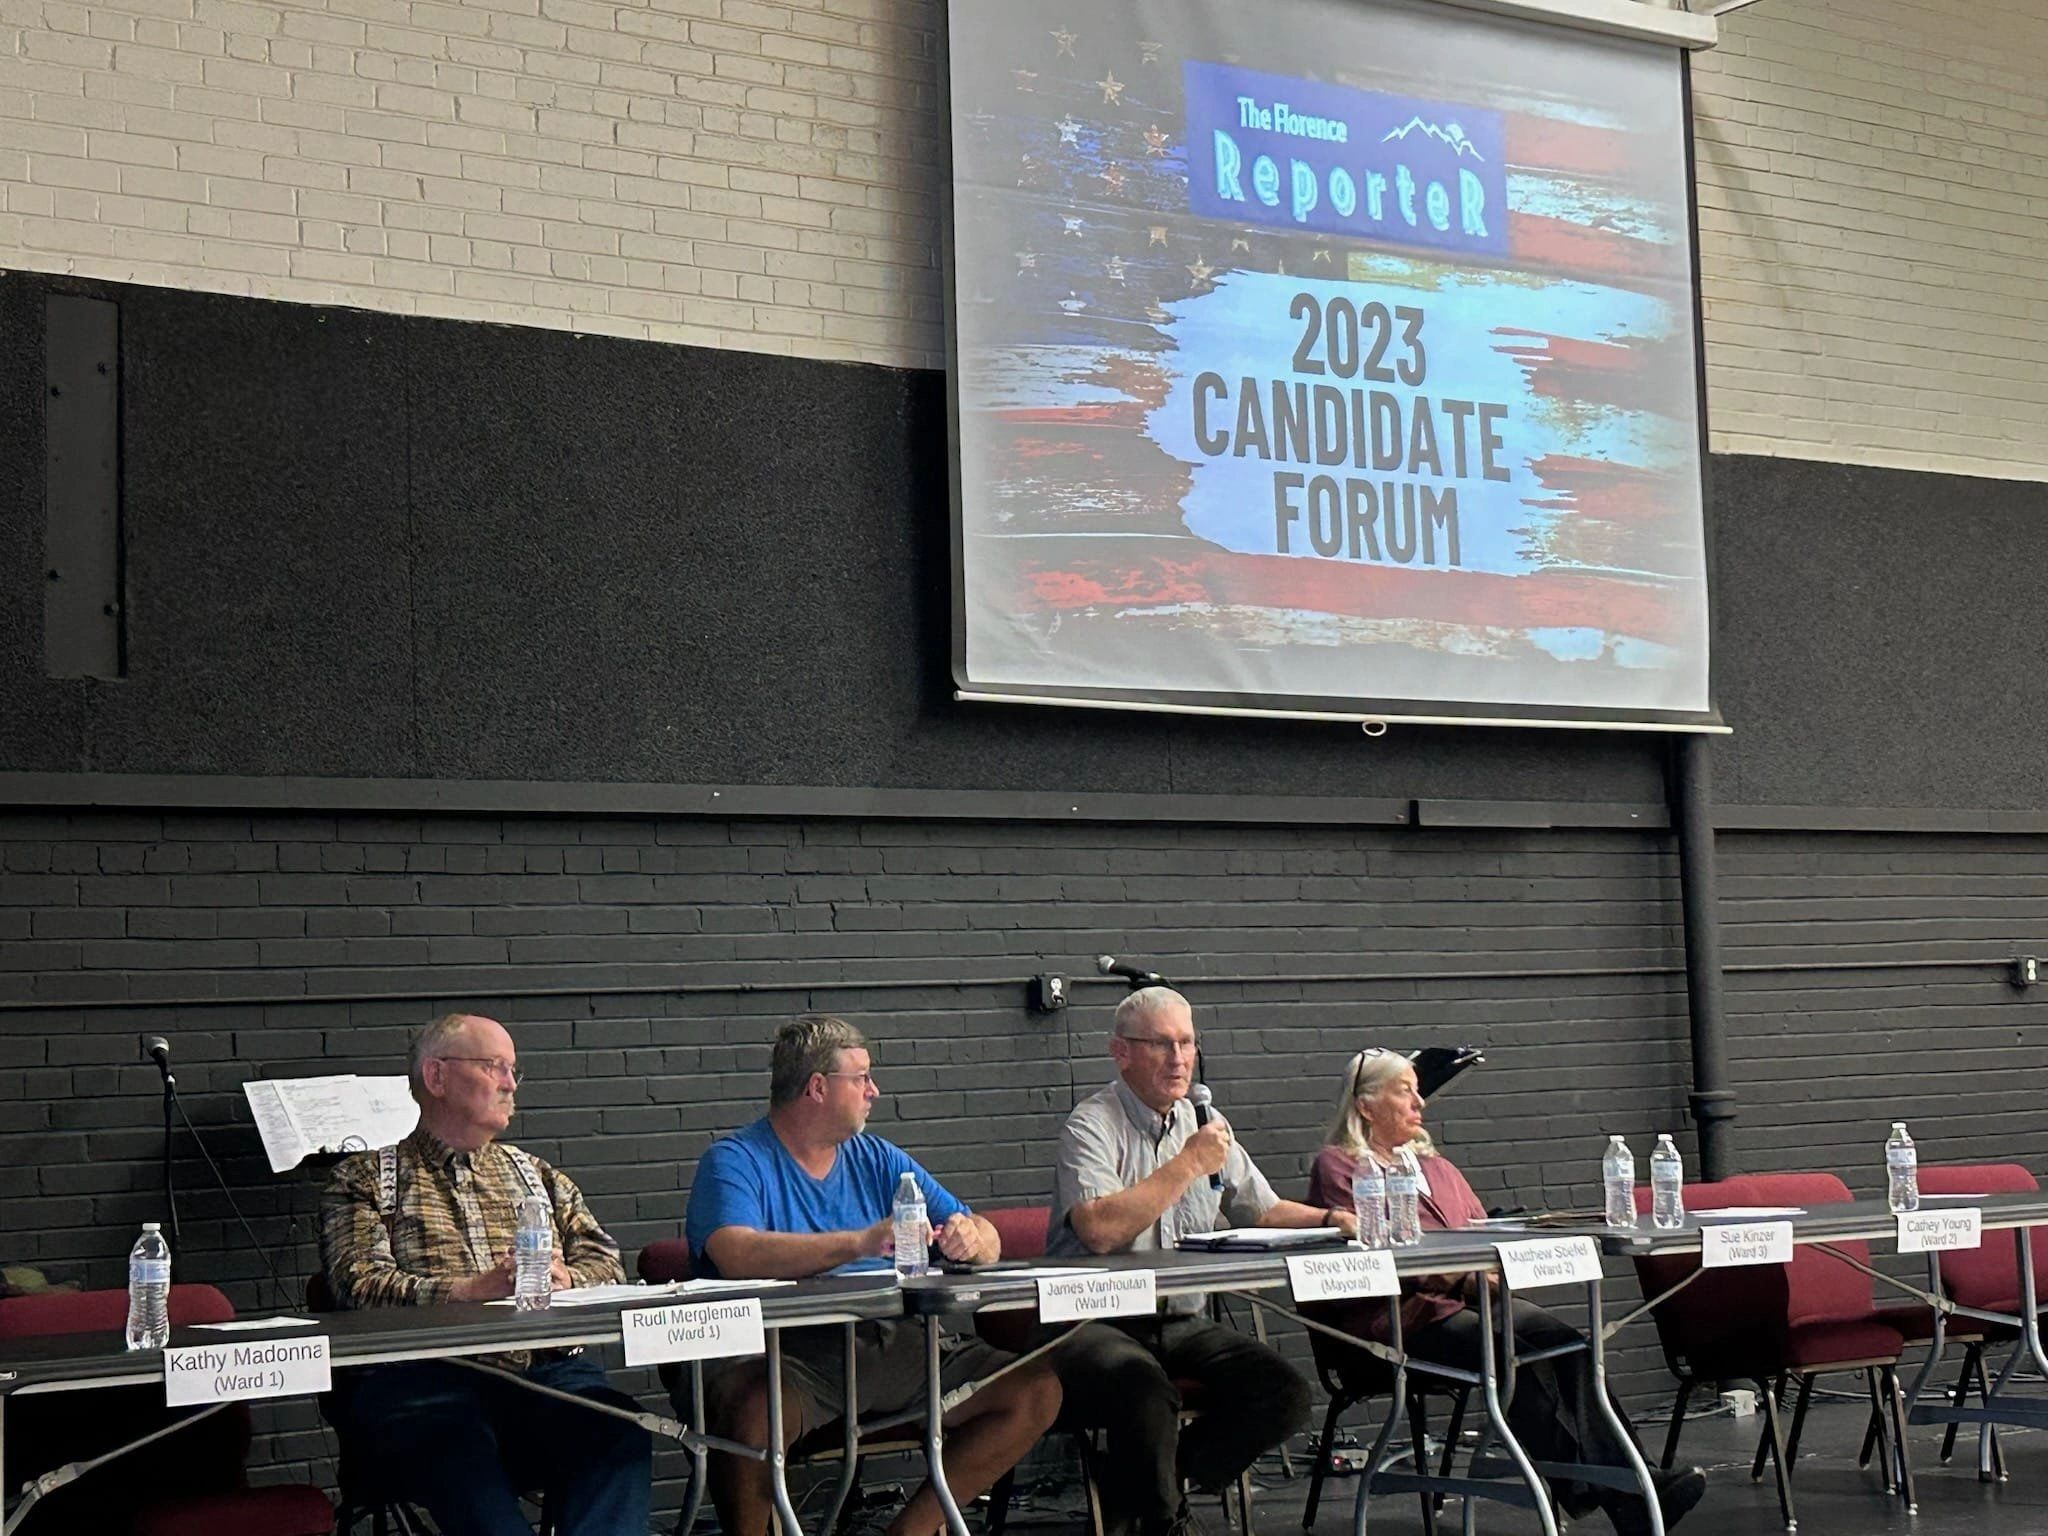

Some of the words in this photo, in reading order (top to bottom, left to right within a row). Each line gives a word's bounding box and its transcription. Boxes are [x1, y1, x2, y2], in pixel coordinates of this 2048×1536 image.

[1237, 96, 1272, 131] The
[1273, 103, 1349, 143] Florence
[1214, 130, 1489, 237] ReporteR
[1289, 292, 1427, 387] 2023
[1193, 371, 1511, 482] CANDIDATE
[1274, 471, 1462, 566] FORUM
[1942, 1218, 1972, 1232] Young
[1720, 1230, 1741, 1244] Sue
[1921, 1234, 1947, 1249] (Ward
[1948, 1233, 1958, 1245] 2)
[1728, 1246, 1757, 1262] (Ward
[1758, 1244, 1769, 1260] 3)
[1303, 1260, 1341, 1275] Steve
[1342, 1255, 1381, 1272] Wolfe
[1533, 1263, 1563, 1280] (Ward
[1563, 1261, 1575, 1277] 2)
[1047, 1282, 1085, 1297] James
[1320, 1276, 1371, 1295] (Mayoral)
[1075, 1296, 1107, 1312] (Ward
[1110, 1293, 1120, 1310] 1)
[671, 1304, 751, 1325] Mergleman
[667, 1325, 705, 1345] (Ward
[709, 1324, 721, 1340] 1)
[170, 1350, 227, 1373] Kathy
[234, 1343, 322, 1366] Madonna
[214, 1371, 264, 1396] (Ward
[269, 1370, 285, 1390] 1)
